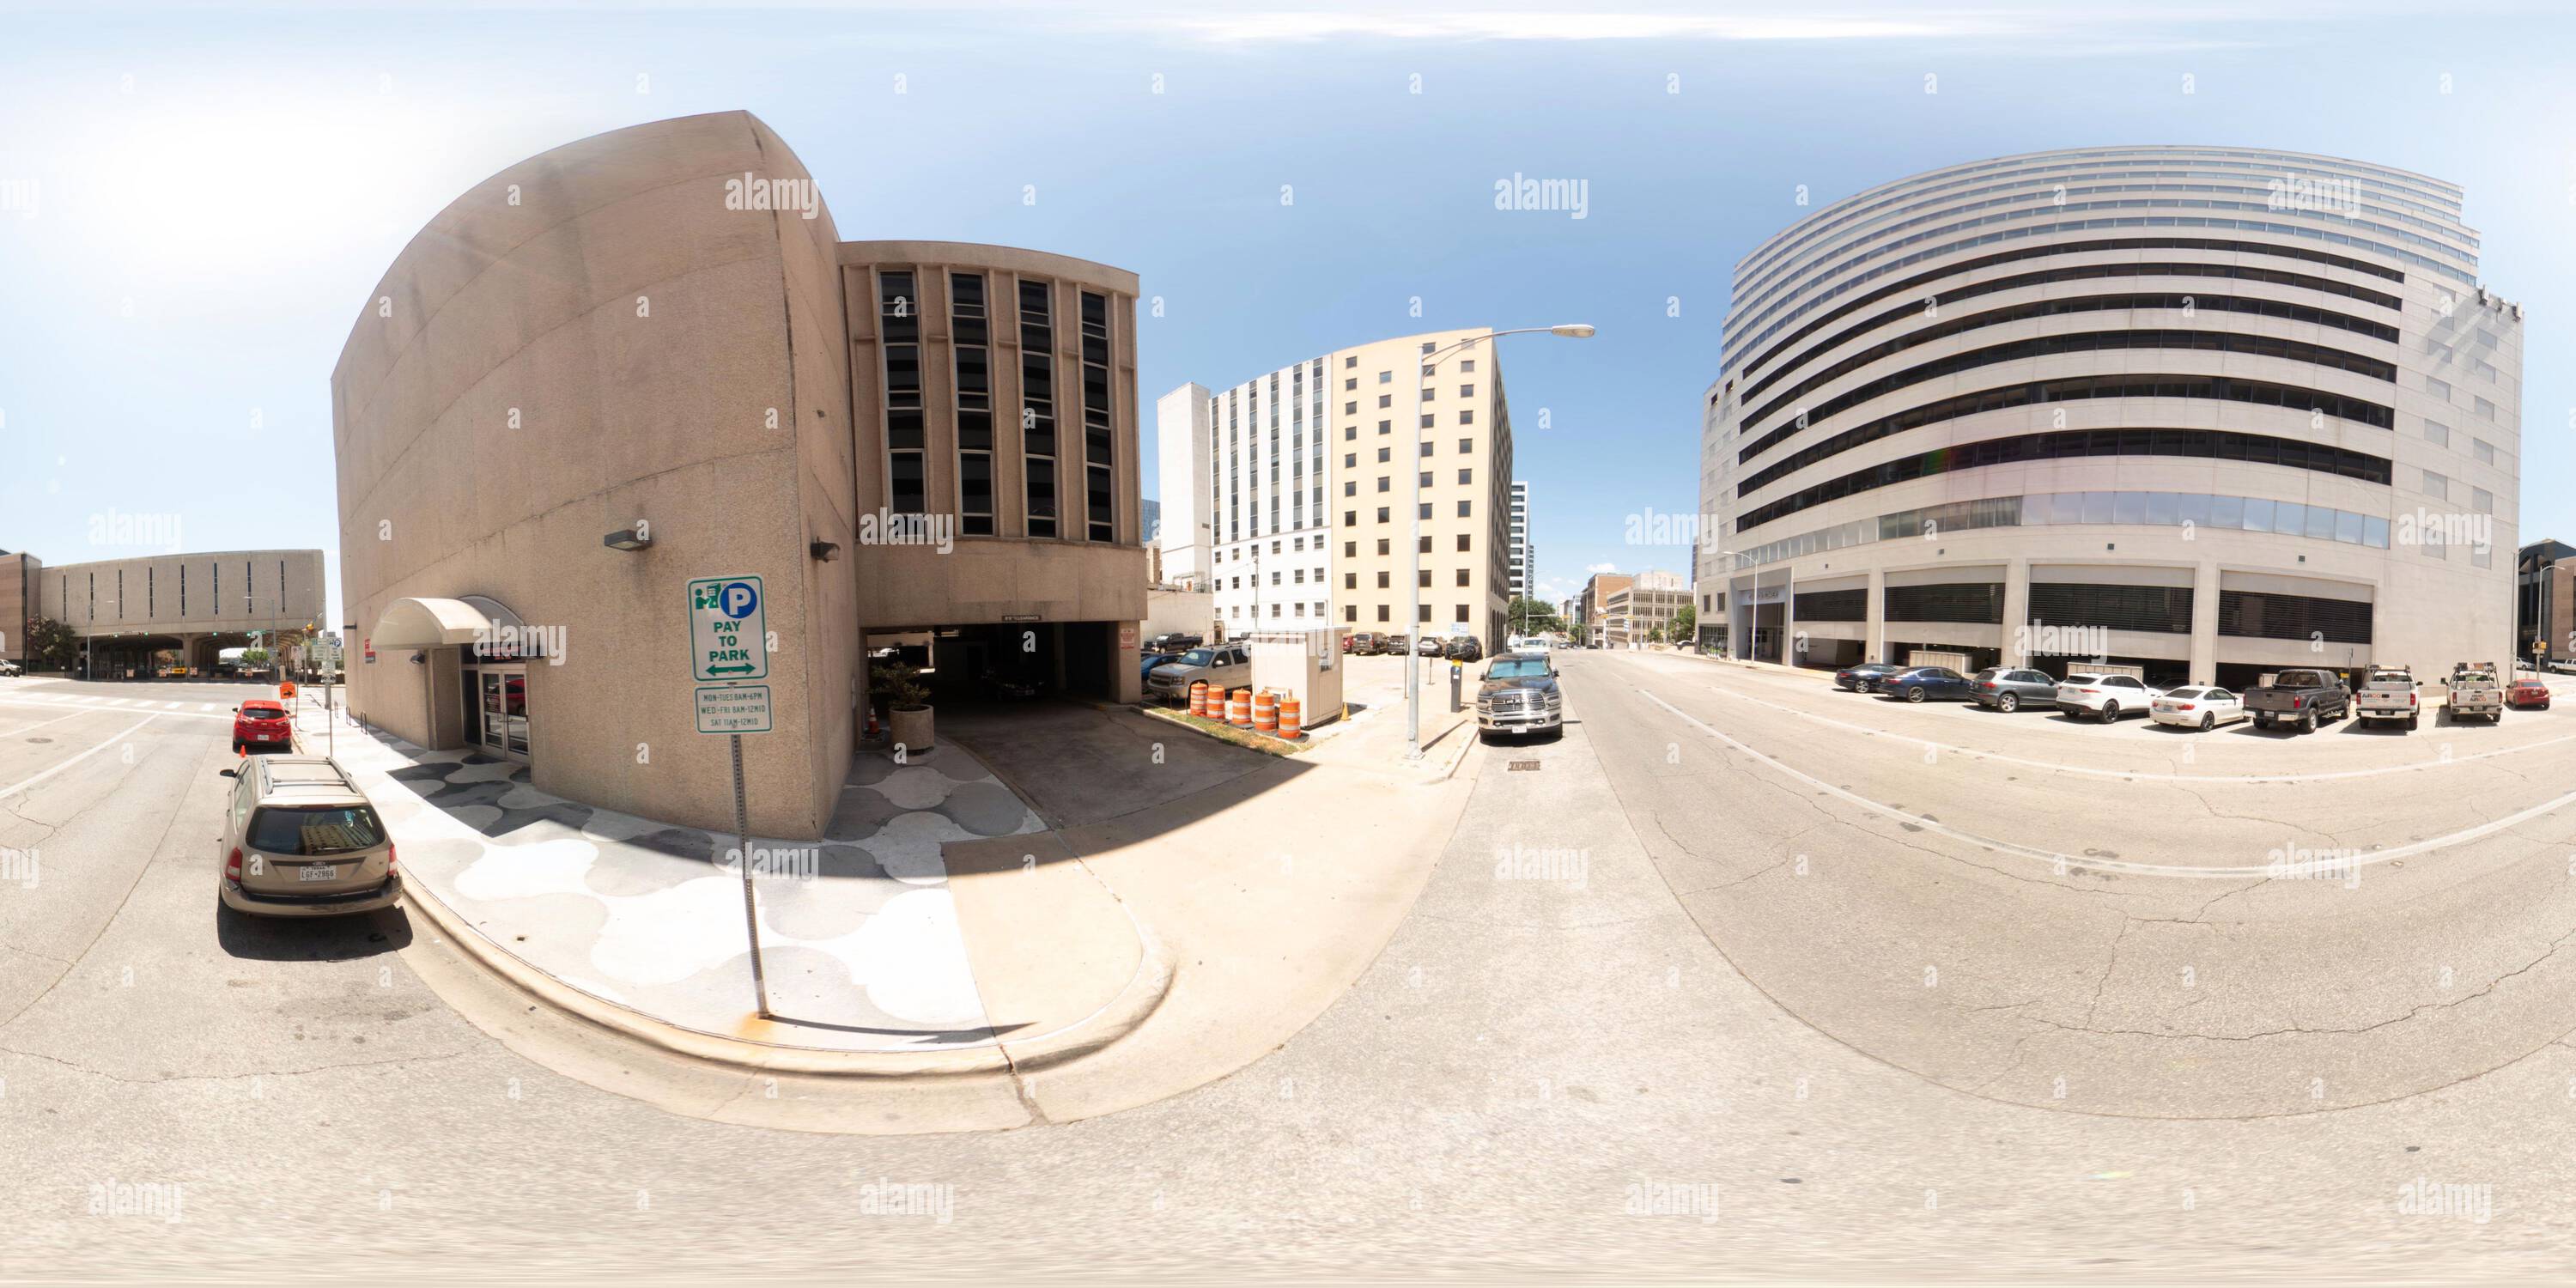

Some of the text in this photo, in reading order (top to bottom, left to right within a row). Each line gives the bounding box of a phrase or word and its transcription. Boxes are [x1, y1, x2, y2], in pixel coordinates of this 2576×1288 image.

[728, 588, 750, 615] P
[714, 621, 741, 633] PAY
[719, 635, 737, 647] TO
[709, 649, 750, 661] PARK
